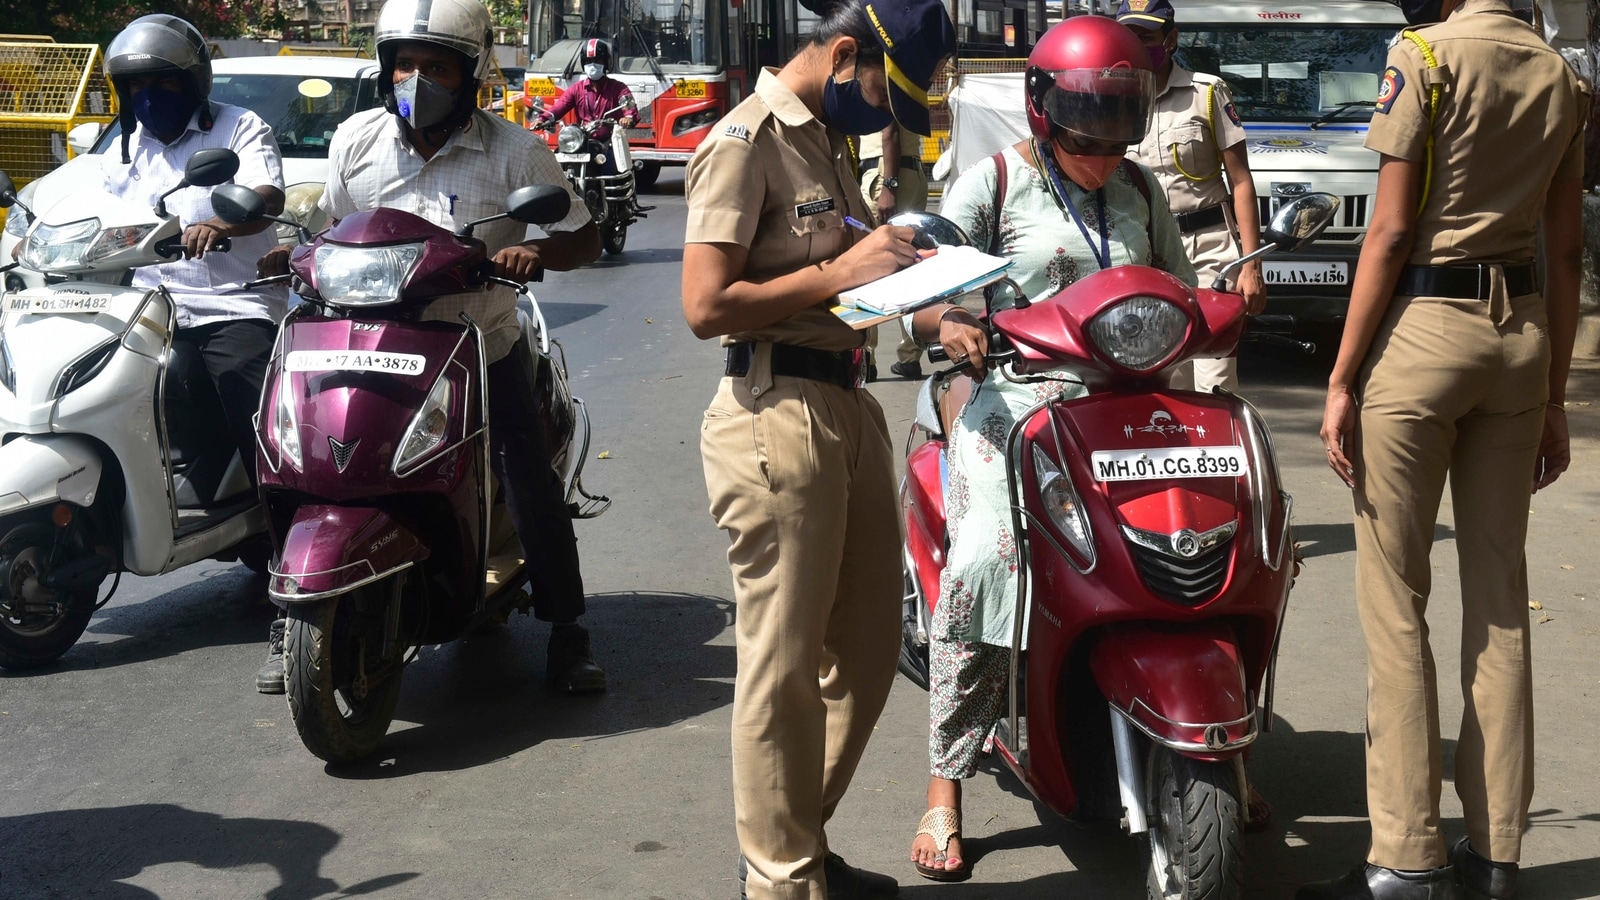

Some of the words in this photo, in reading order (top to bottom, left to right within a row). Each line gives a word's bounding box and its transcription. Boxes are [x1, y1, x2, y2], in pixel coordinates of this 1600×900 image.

[1257, 11, 1302, 19] पोलीस
[877, 26, 894, 48] POLICE
[353, 322, 381, 331] TVS
[382, 357, 418, 371] 3878
[1038, 602, 1062, 629] YAMAHA
